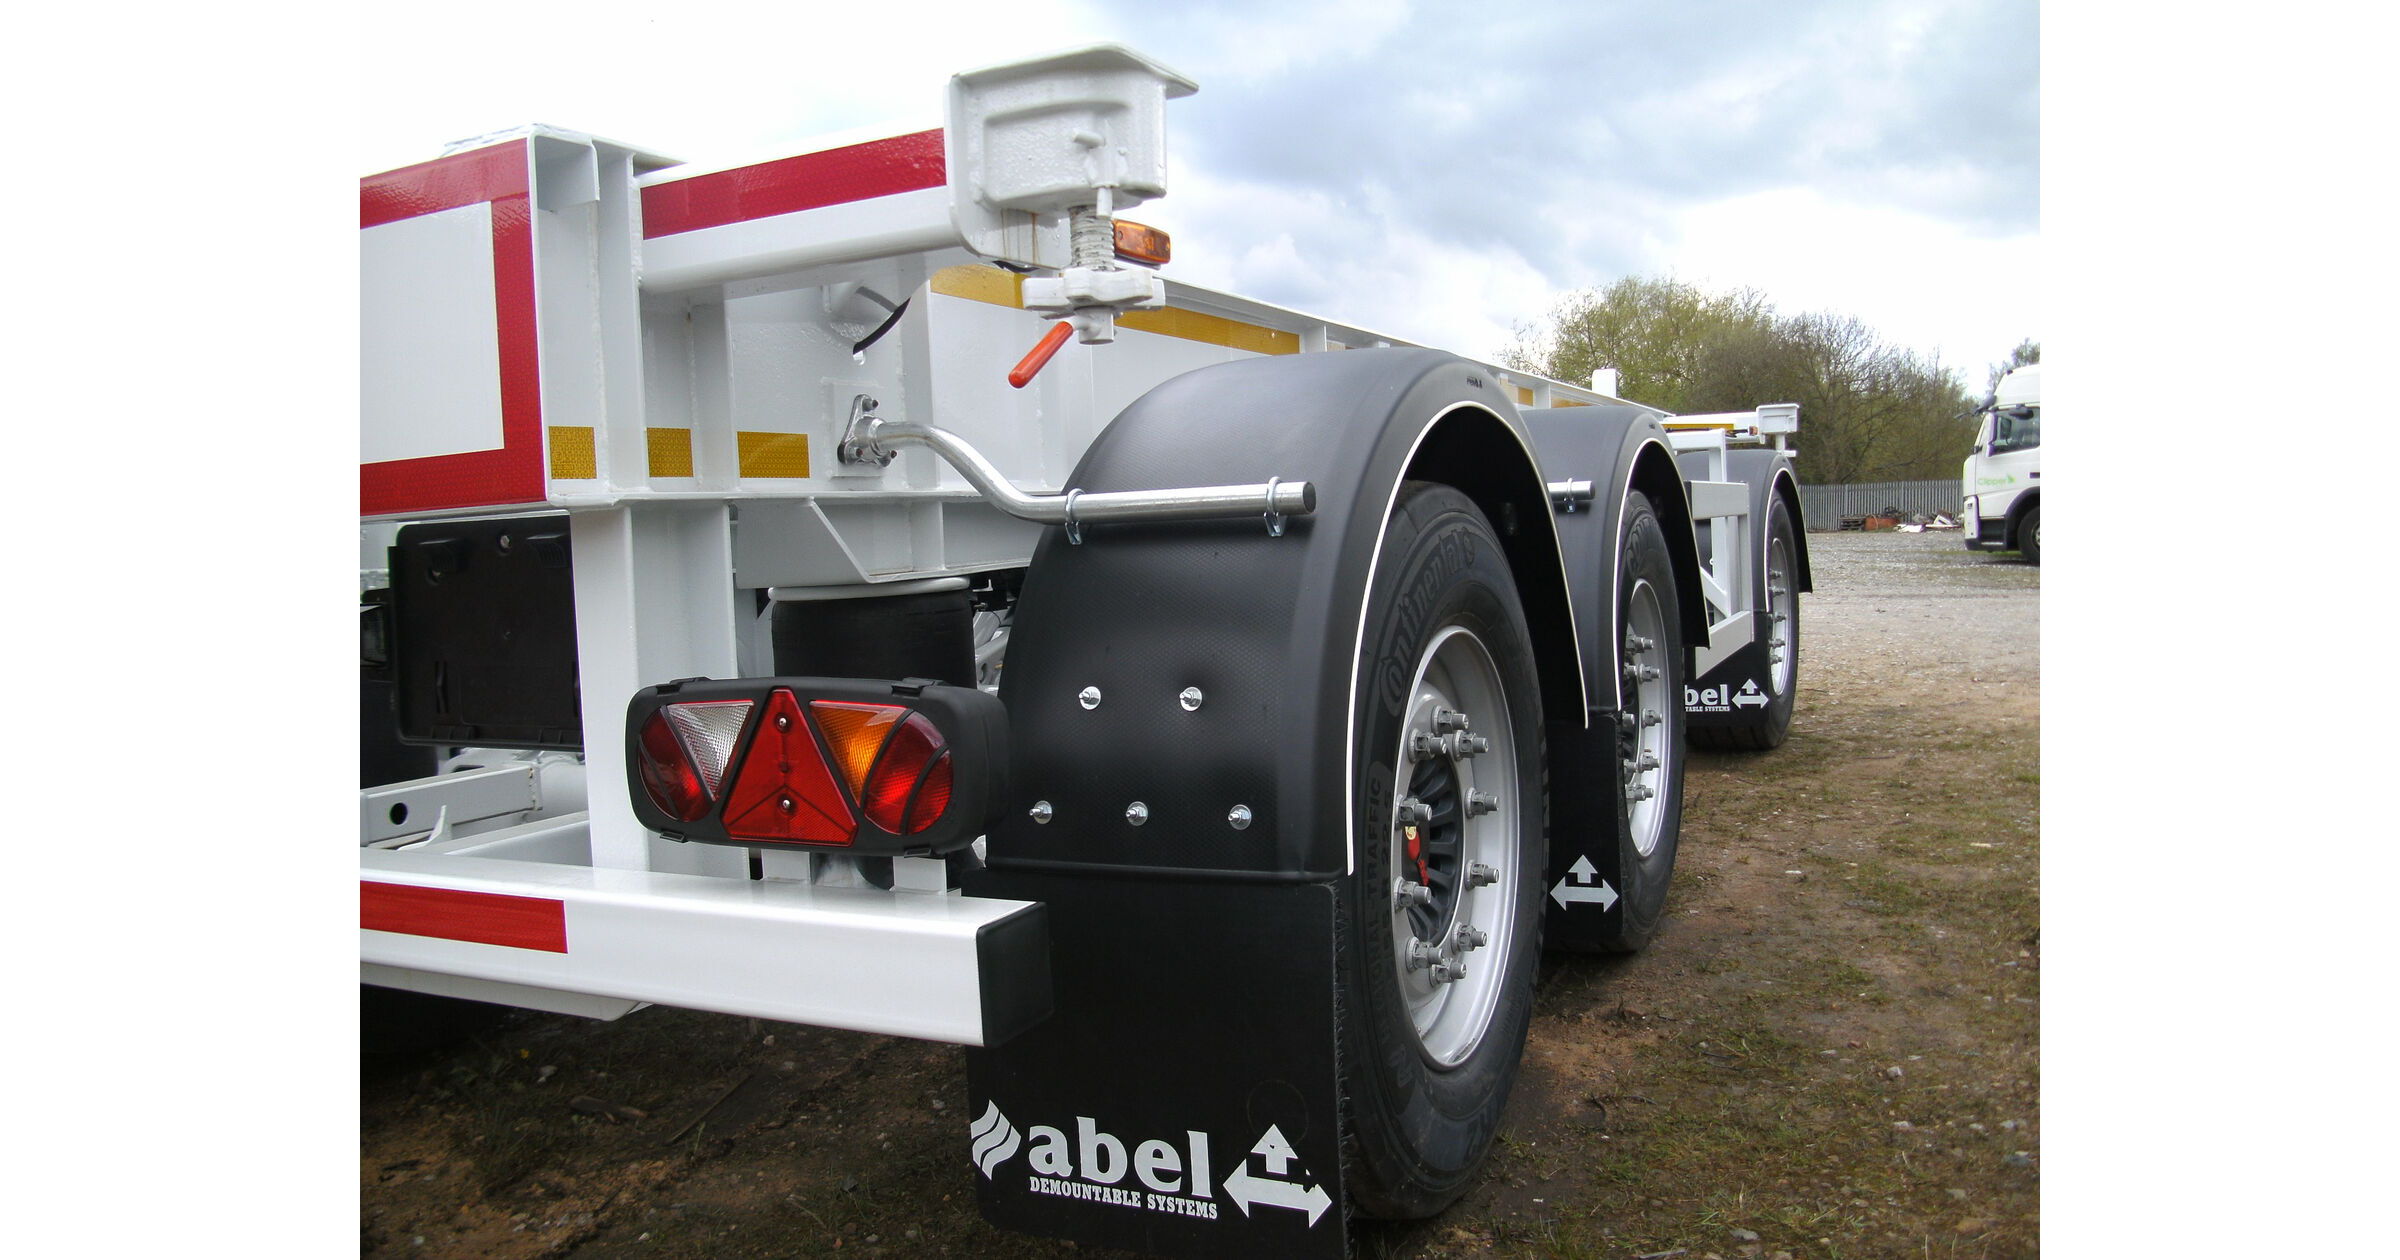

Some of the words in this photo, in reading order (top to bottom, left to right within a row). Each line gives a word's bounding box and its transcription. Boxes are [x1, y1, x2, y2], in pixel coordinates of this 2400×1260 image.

[1379, 527, 1466, 717] Continental
[1684, 684, 1729, 706] bel
[1028, 1116, 1213, 1198] abel
[1029, 1176, 1141, 1208] DEMOUNTABLE
[1147, 1193, 1218, 1220] SYSTEMS
